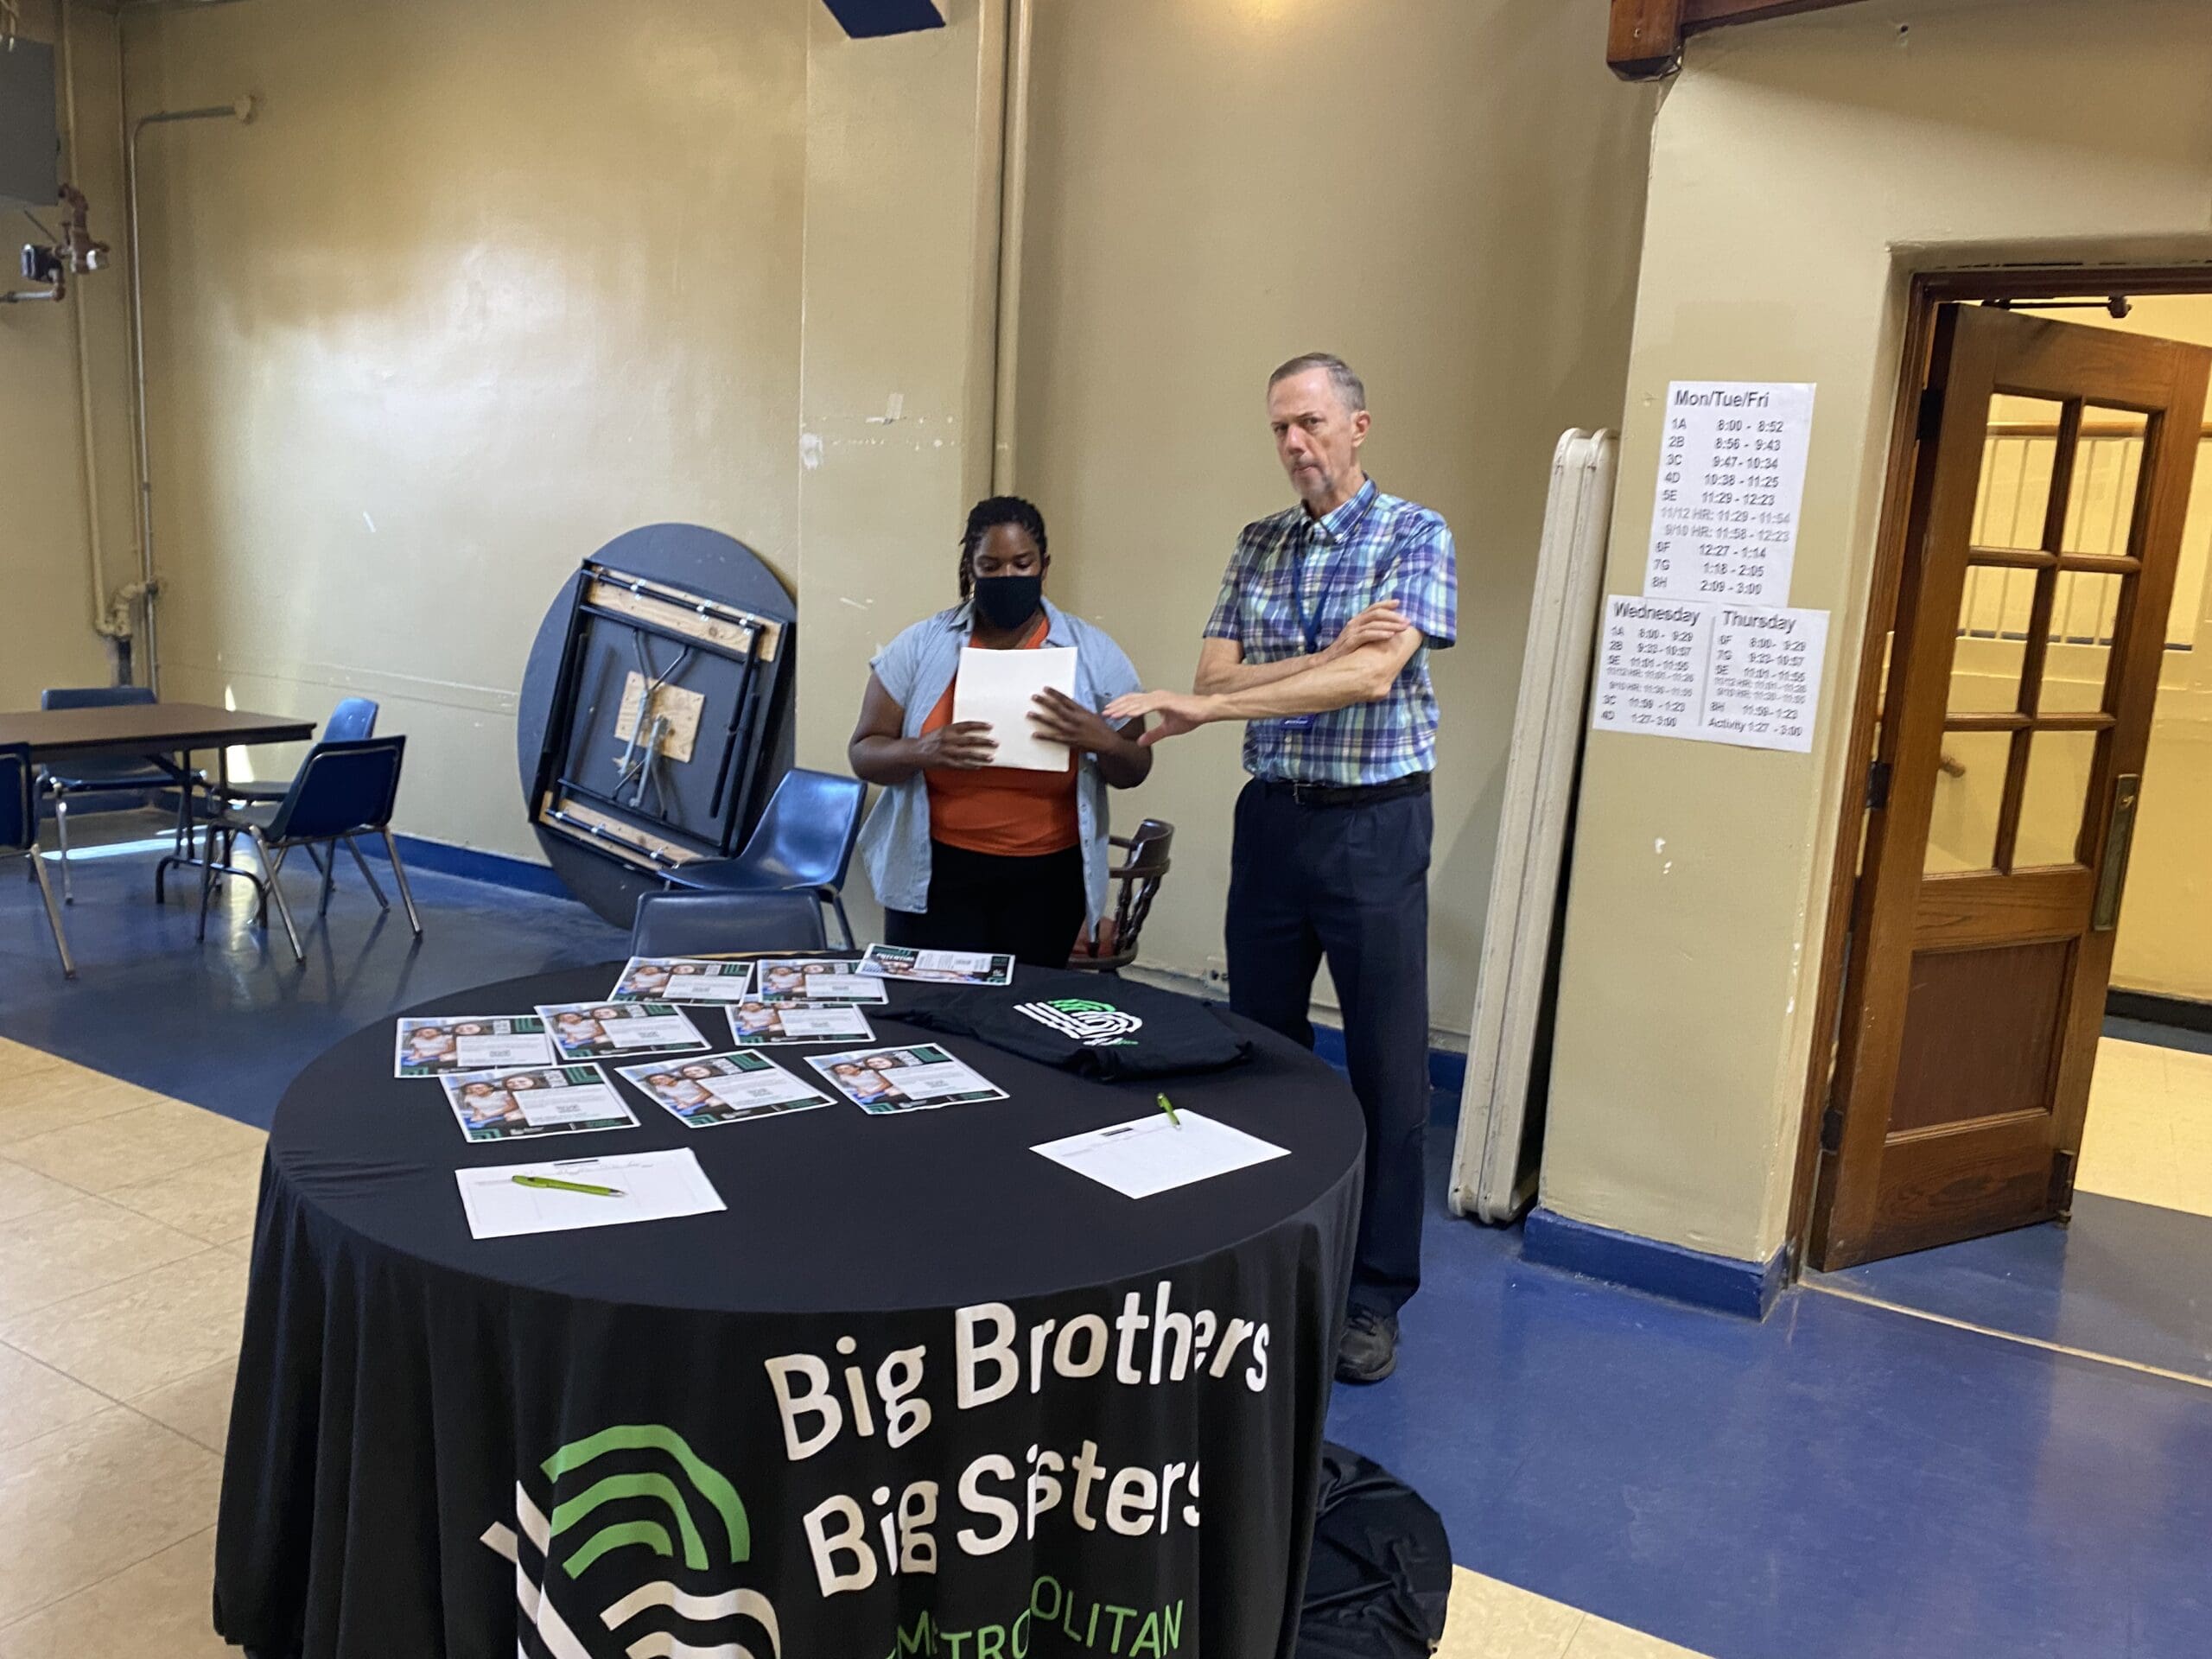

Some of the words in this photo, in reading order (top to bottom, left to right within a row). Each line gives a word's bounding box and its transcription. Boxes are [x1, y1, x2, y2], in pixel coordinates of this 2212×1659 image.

[1675, 390, 1770, 408] Mon/Tue/Fri
[1672, 418, 1687, 429] 1A
[1717, 419, 1743, 431] 8:00
[1758, 421, 1784, 433] 8:52
[1669, 436, 1685, 447] 2B
[1715, 438, 1740, 449] 8:56
[1756, 439, 1781, 451] 9:43
[1667, 454, 1682, 465] 3C
[1713, 455, 1738, 467] 9:47
[1747, 457, 1778, 469] 10:34
[1664, 472, 1681, 483] 4D
[1705, 474, 1736, 486] 10:38
[1748, 475, 1779, 488] 11:25
[1662, 490, 1678, 501] 5E
[1701, 492, 1732, 505] 11:29
[1743, 493, 1775, 505] 12:23
[1718, 510, 1749, 522] 11:29
[1758, 530, 1790, 543] 12:23
[1700, 543, 1730, 556] 12:27
[1741, 546, 1766, 558] 1:14
[1654, 559, 1670, 570] 7G
[1703, 563, 1728, 575] 1:18
[1738, 564, 1764, 577] 2:05
[1652, 576, 1668, 588] 8H
[1700, 580, 1726, 592] 2:09
[1612, 601, 1700, 626] Wednesday
[1723, 610, 1797, 634] Thursday
[1707, 717, 1745, 733] Activity
[764, 1336, 931, 1460] Big
[955, 1281, 1269, 1409] Brothers
[803, 1480, 938, 1597] Big
